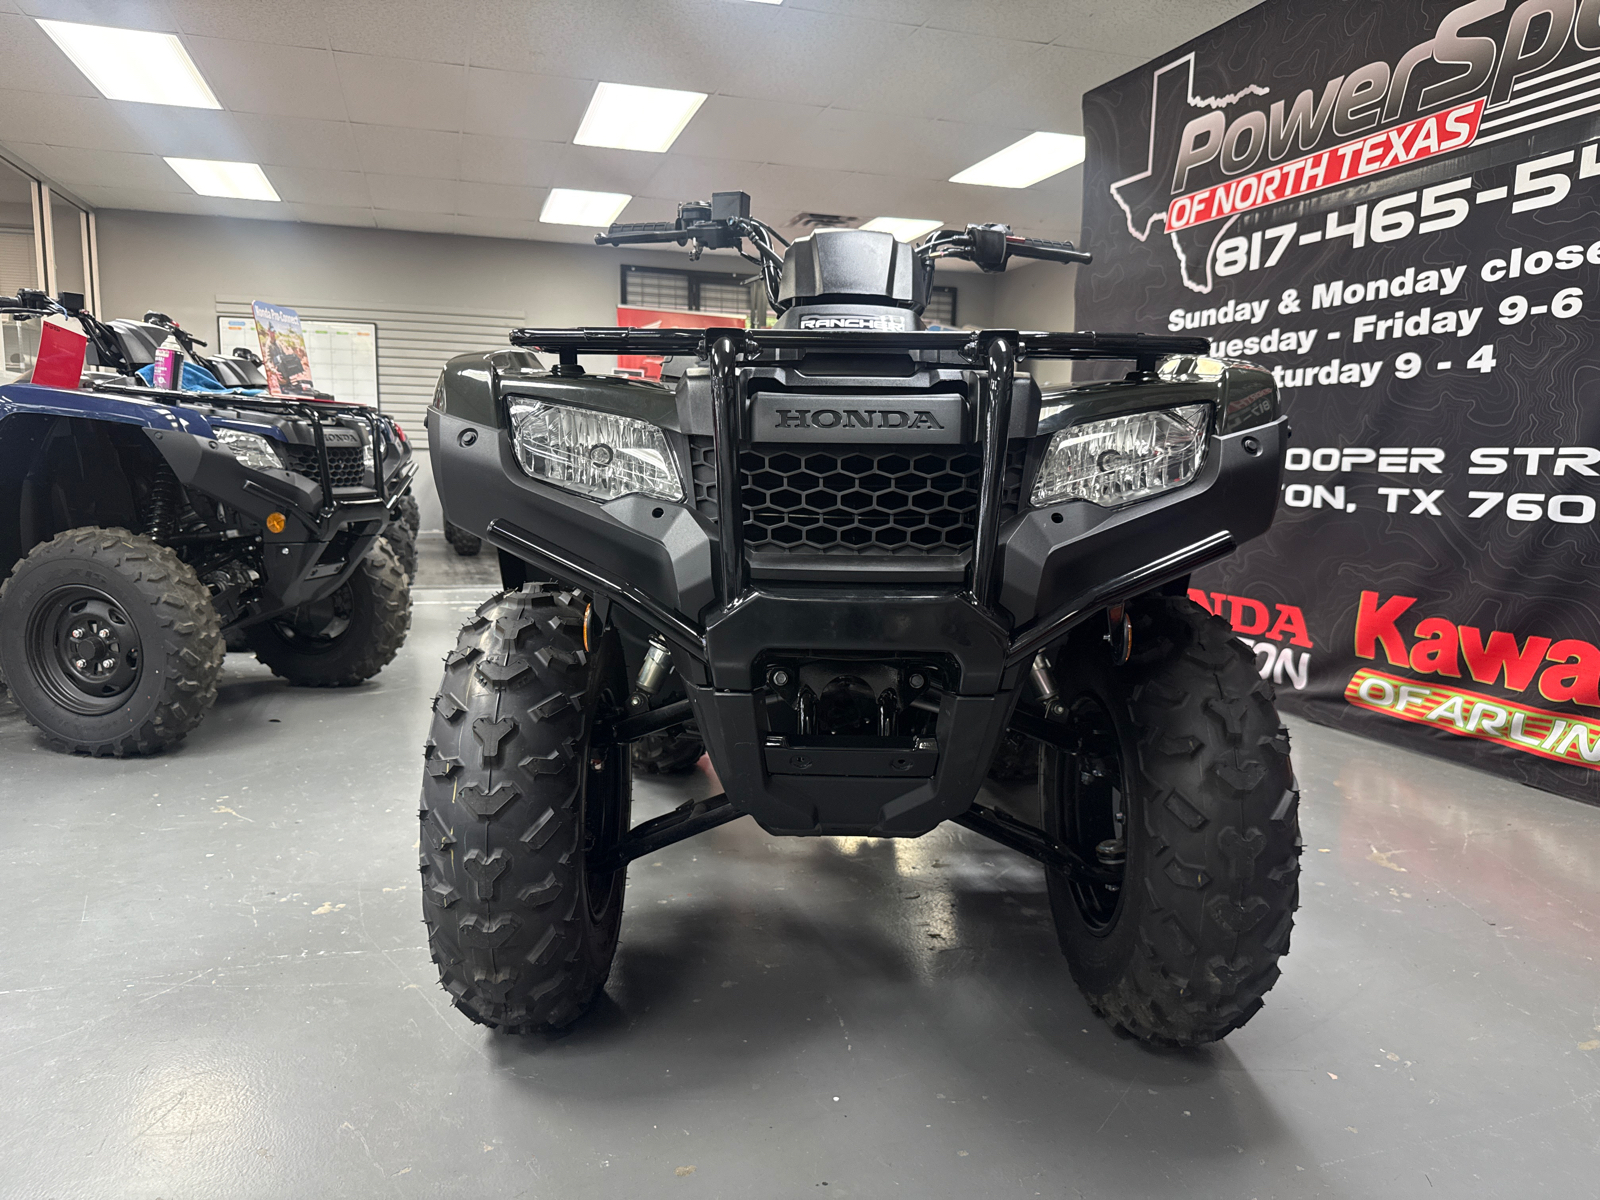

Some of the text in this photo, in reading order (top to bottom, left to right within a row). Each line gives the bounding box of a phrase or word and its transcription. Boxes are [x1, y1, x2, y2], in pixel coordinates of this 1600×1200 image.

[1169, 103, 1477, 229] OF NORTH TEXAS
[254, 305, 271, 319] Honda
[1167, 298, 1270, 332] Sunday
[1278, 289, 1302, 315] &
[1311, 264, 1467, 310] Monday
[801, 318, 905, 331] RANCHER
[1208, 328, 1318, 358] uesday
[1353, 306, 1484, 344] Friday
[1498, 287, 1584, 326] 9-6
[1394, 352, 1421, 380] 9
[1466, 345, 1496, 374] 4
[774, 409, 945, 430] HONDA
[1467, 446, 1600, 476] STR
[1281, 483, 1597, 524] ON, TX 760
[1236, 636, 1311, 690] ON
[1355, 590, 1600, 707] Kawa
[1358, 677, 1431, 711] OF
